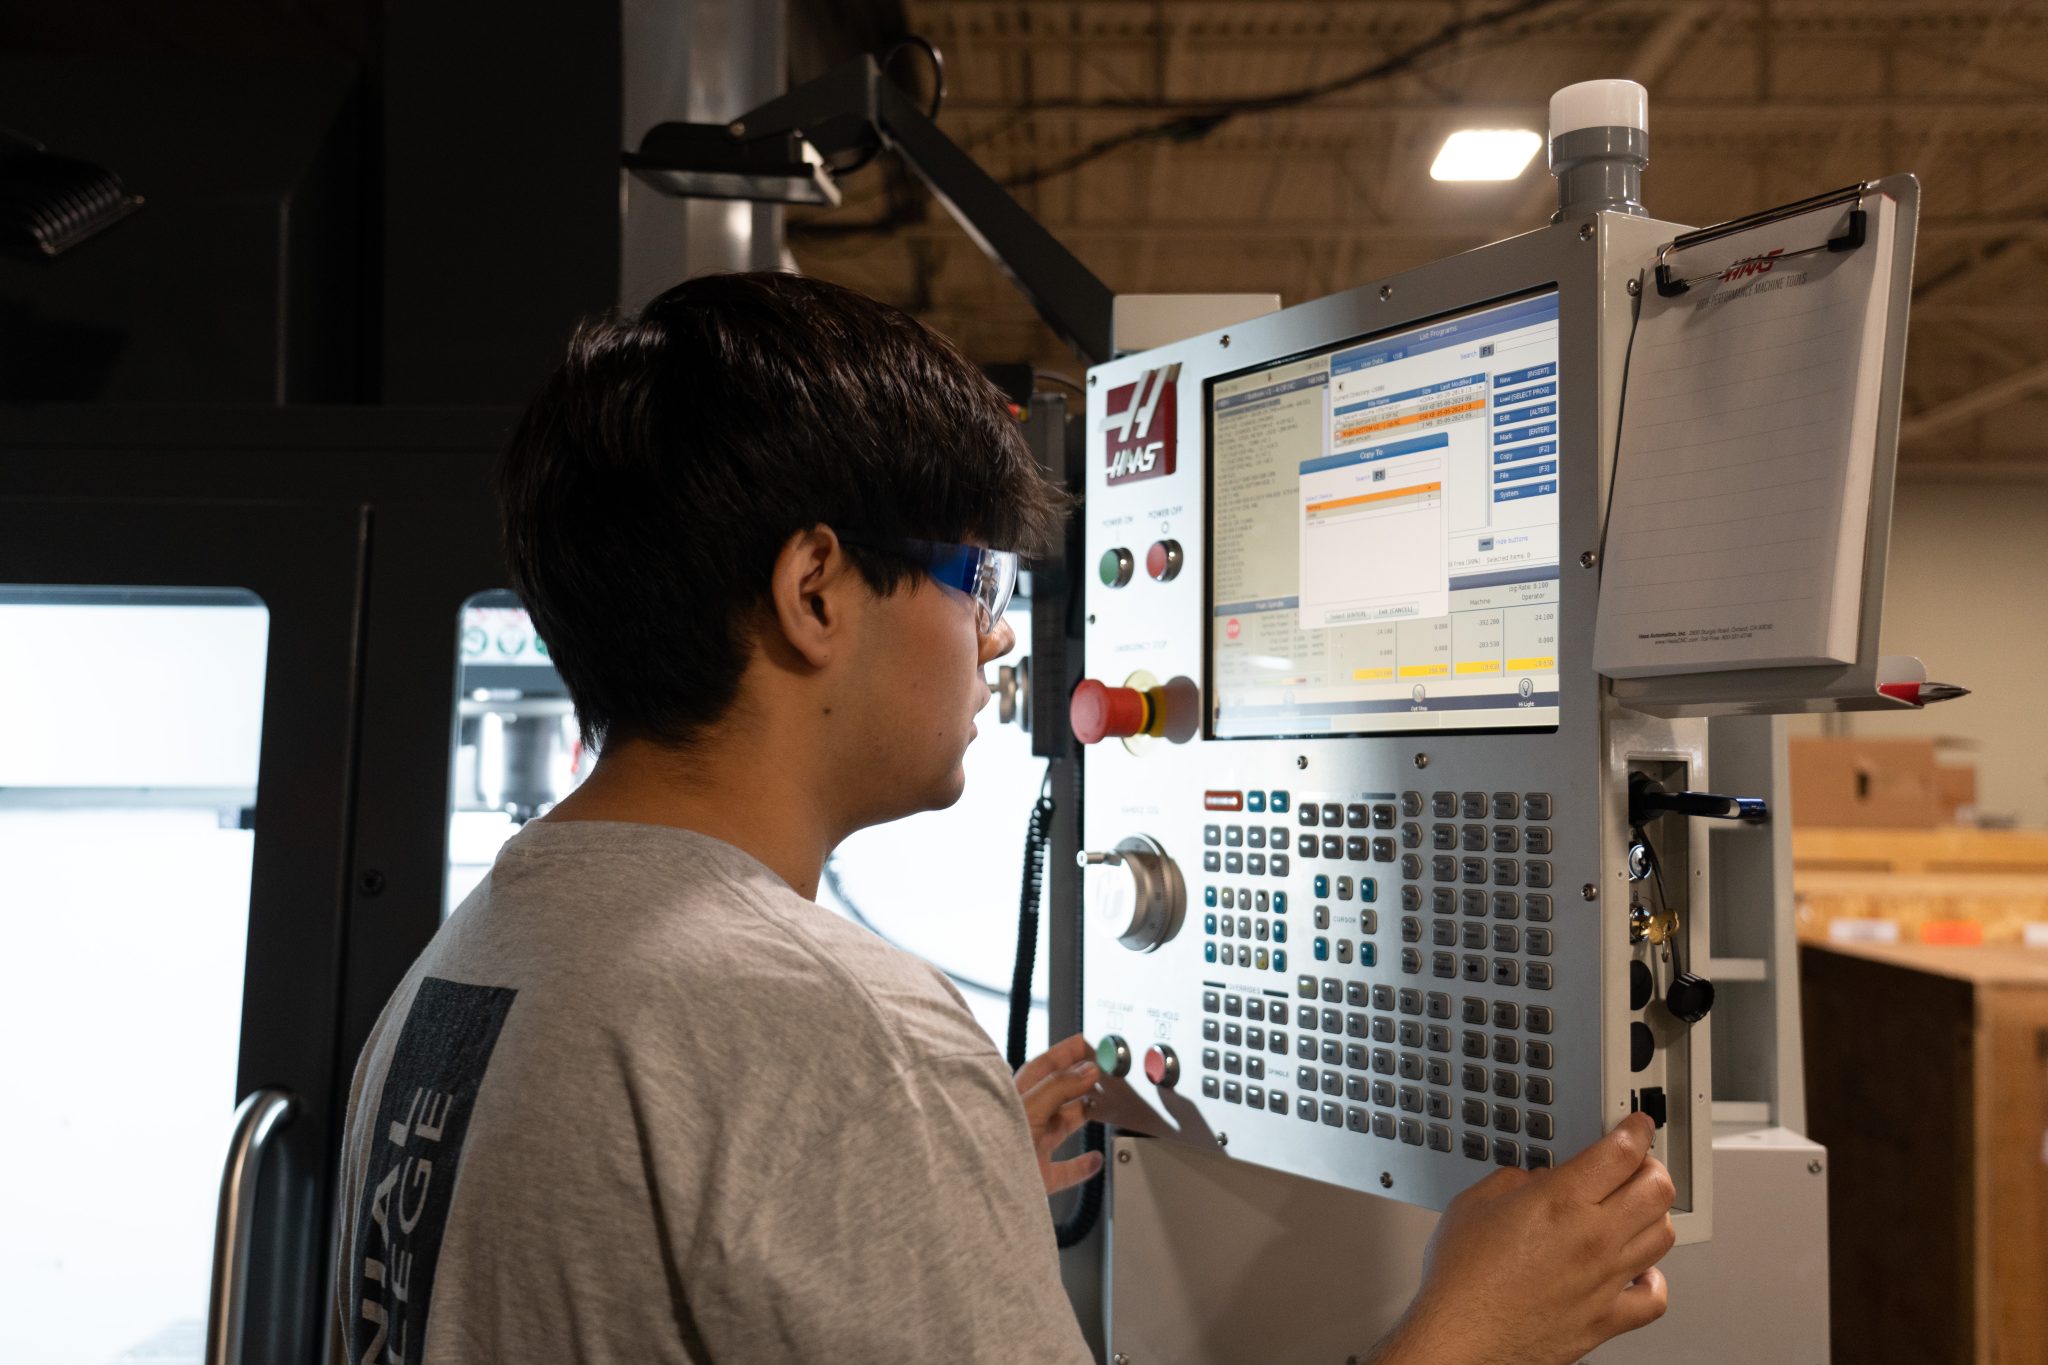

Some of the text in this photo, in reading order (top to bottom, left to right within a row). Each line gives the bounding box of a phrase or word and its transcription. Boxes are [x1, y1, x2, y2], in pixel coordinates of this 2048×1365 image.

[1755, 276, 1784, 294] MACHINE
[1786, 272, 1808, 288] TOOLS
[1420, 325, 1457, 340] List Programs
[1482, 346, 1491, 356] F1
[1528, 367, 1550, 378] [INSERT]
[1440, 383, 1450, 391] Last
[1452, 378, 1472, 388] Modified
[1512, 390, 1532, 402] [SELECT
[1532, 386, 1550, 396] PROG]
[1530, 406, 1550, 416] [ALTER]
[1528, 426, 1550, 436] [ENTER]
[1360, 448, 1384, 460] Copy To
[1538, 445, 1550, 454] [F2]
[1104, 442, 1164, 478] HAAS
[1538, 464, 1550, 474] [F3]
[1500, 484, 1550, 500] System [F4]
[1333, 916, 1356, 924] CURSOR
[1228, 982, 1262, 995] OVERRIDES
